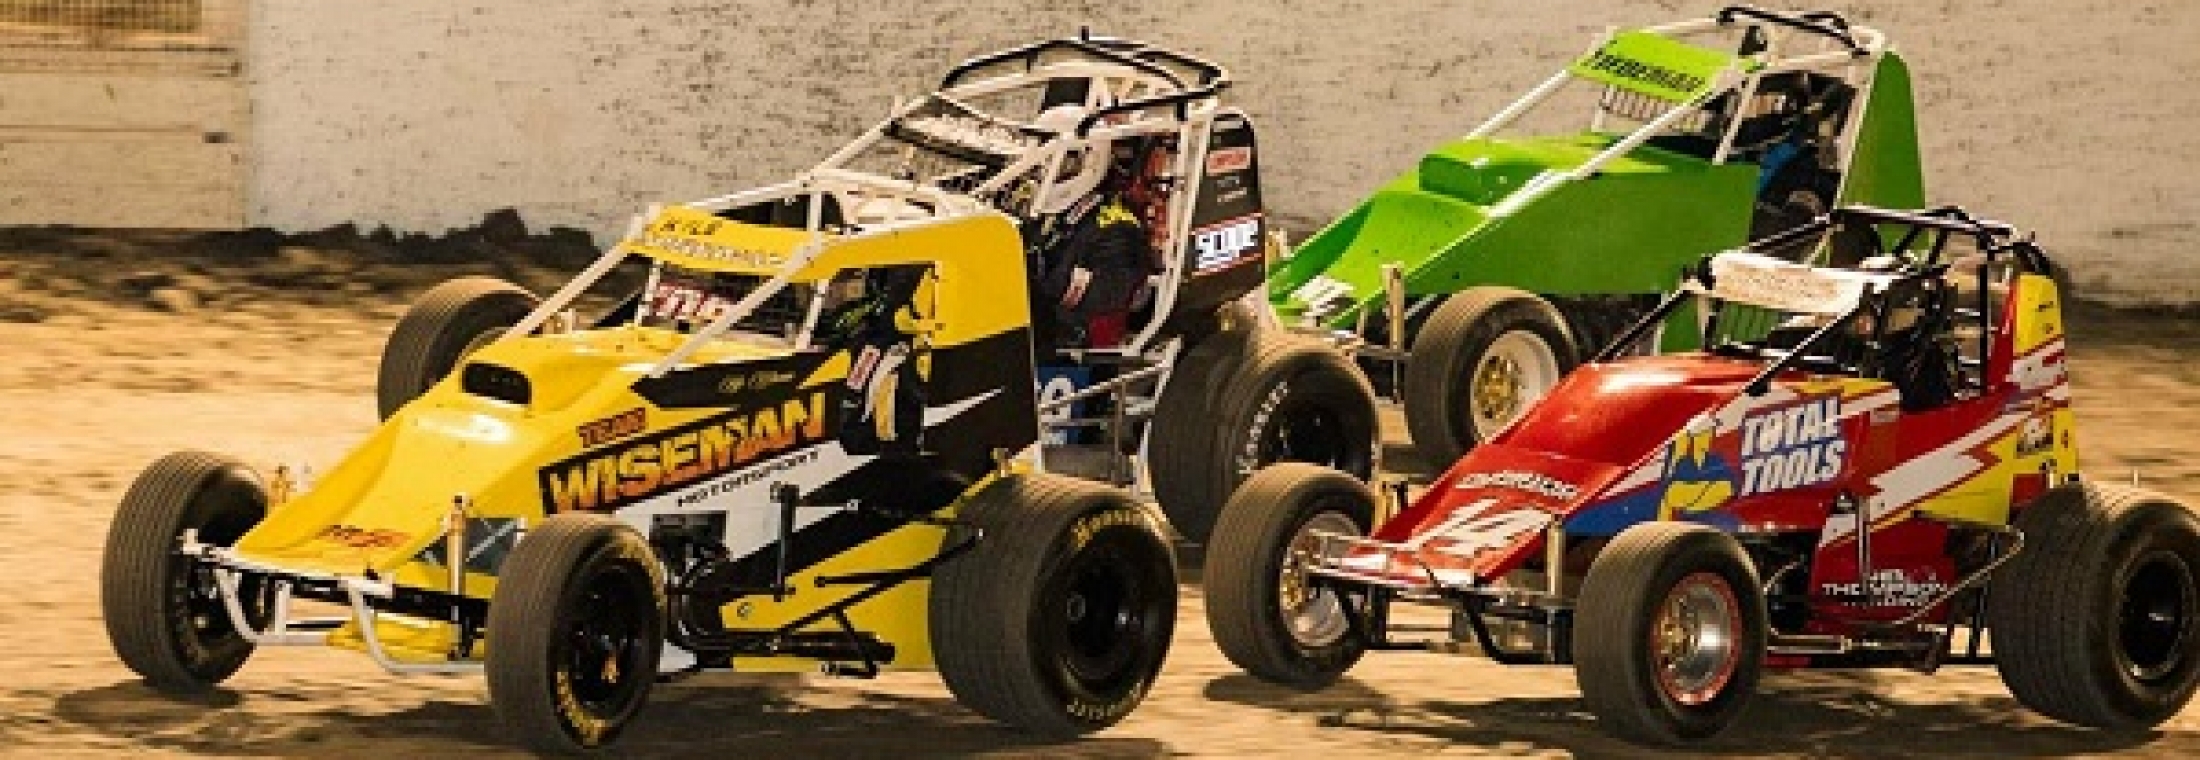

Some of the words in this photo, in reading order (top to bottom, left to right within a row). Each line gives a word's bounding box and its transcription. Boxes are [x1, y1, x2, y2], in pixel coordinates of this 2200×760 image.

[550, 391, 823, 515] WISEMAN
[1742, 397, 1842, 457] TOTAL
[1742, 440, 1846, 497] TOOLS
